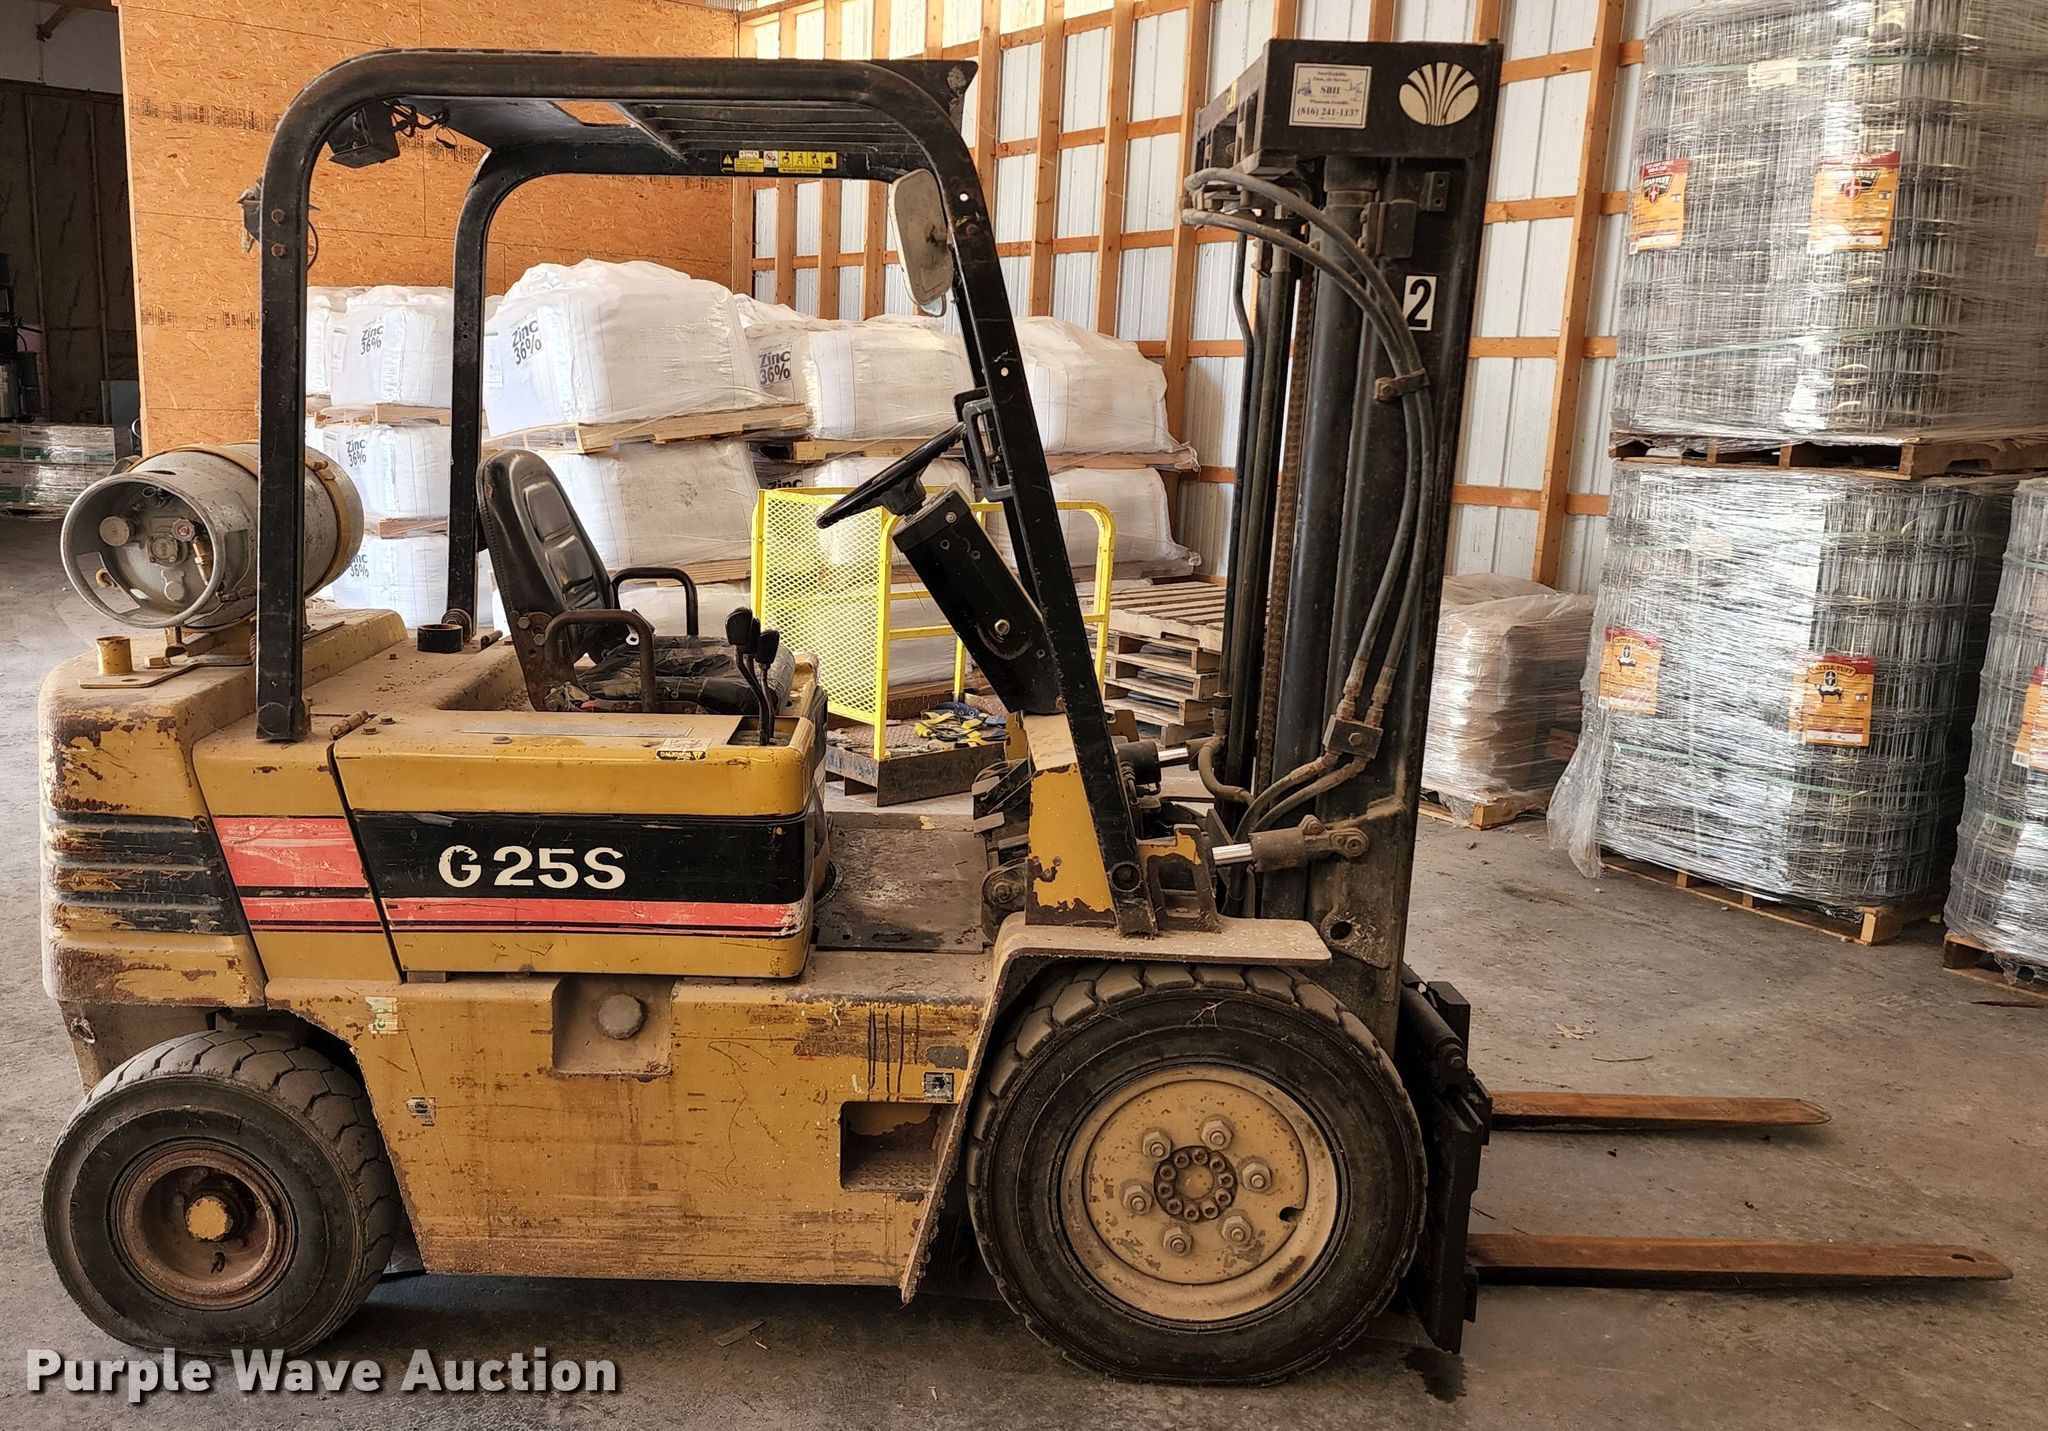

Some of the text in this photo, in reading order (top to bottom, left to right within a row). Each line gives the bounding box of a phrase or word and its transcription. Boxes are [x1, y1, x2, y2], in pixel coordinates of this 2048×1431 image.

[1320, 86, 1341, 95] SBH
[1297, 107, 1359, 117] (816) 241-1137
[1406, 279, 1432, 328] 2
[361, 325, 384, 342] Zinc
[511, 320, 538, 348] Zinc
[360, 336, 383, 356] 36%
[513, 333, 542, 366] 36%
[759, 351, 792, 369] Zinc
[759, 363, 792, 385] 36%
[345, 439, 366, 454] Zinc
[348, 450, 367, 468] 36%
[352, 554, 368, 564] nc
[350, 563, 370, 578] 36%
[438, 845, 626, 889] G 25S
